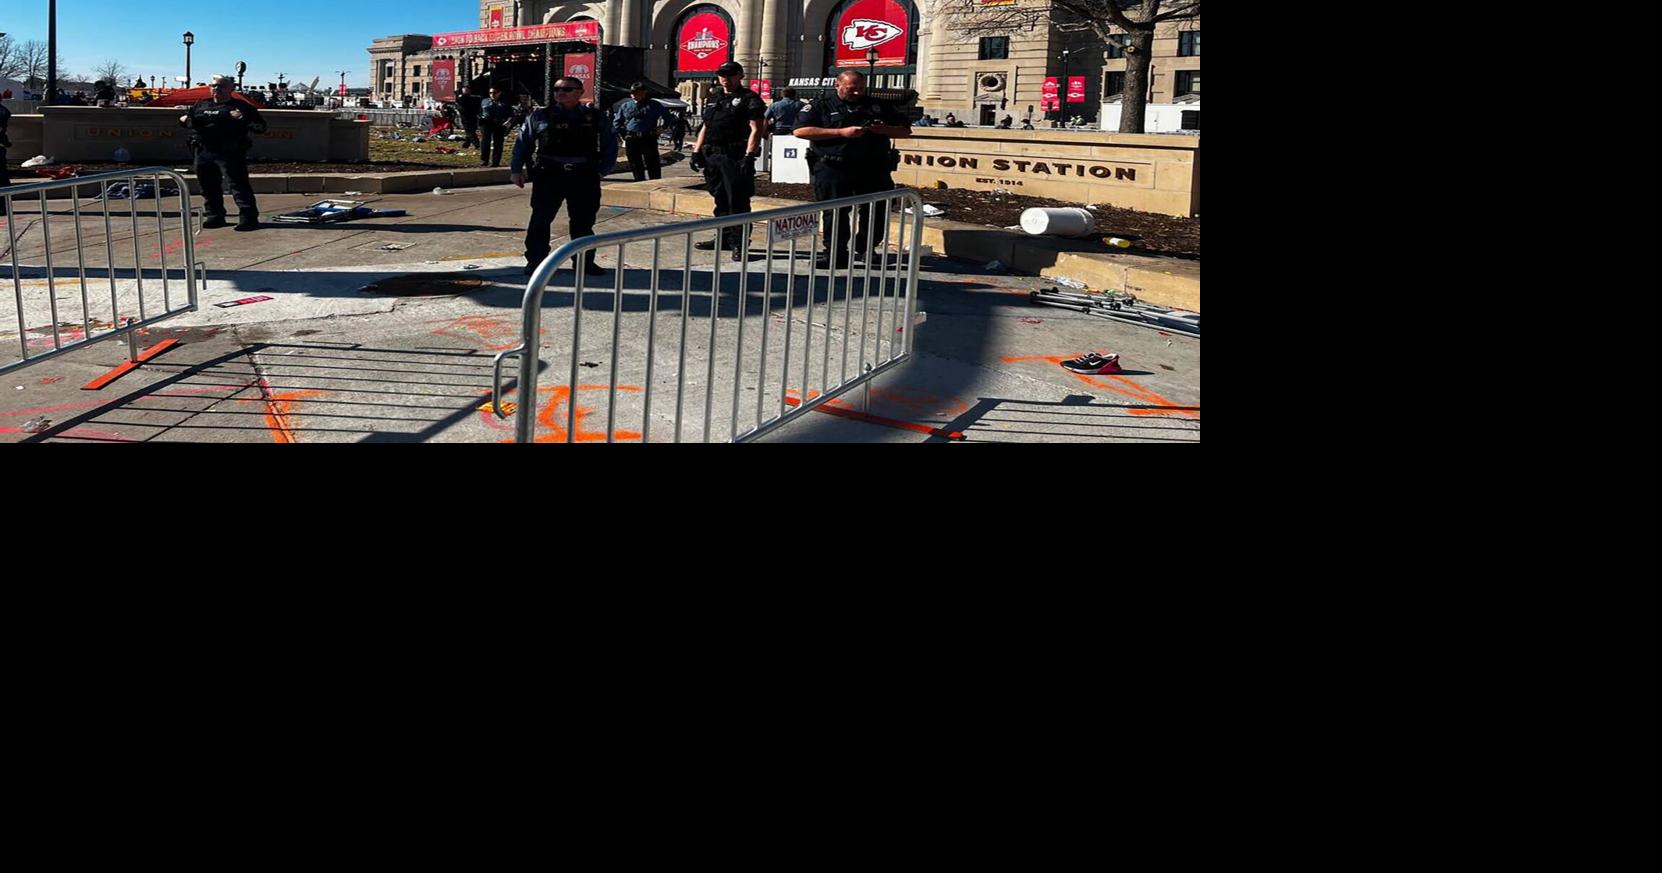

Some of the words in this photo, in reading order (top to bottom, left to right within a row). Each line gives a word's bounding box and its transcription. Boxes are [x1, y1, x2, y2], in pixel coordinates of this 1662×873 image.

[856, 24, 887, 41] KC
[788, 77, 820, 86] KANSAS
[87, 128, 174, 137] UNION
[899, 153, 978, 169] NION
[992, 158, 1137, 181] STATION
[975, 176, 997, 185] EST.
[999, 178, 1024, 187] 1914
[775, 213, 819, 232] NATIONAL
